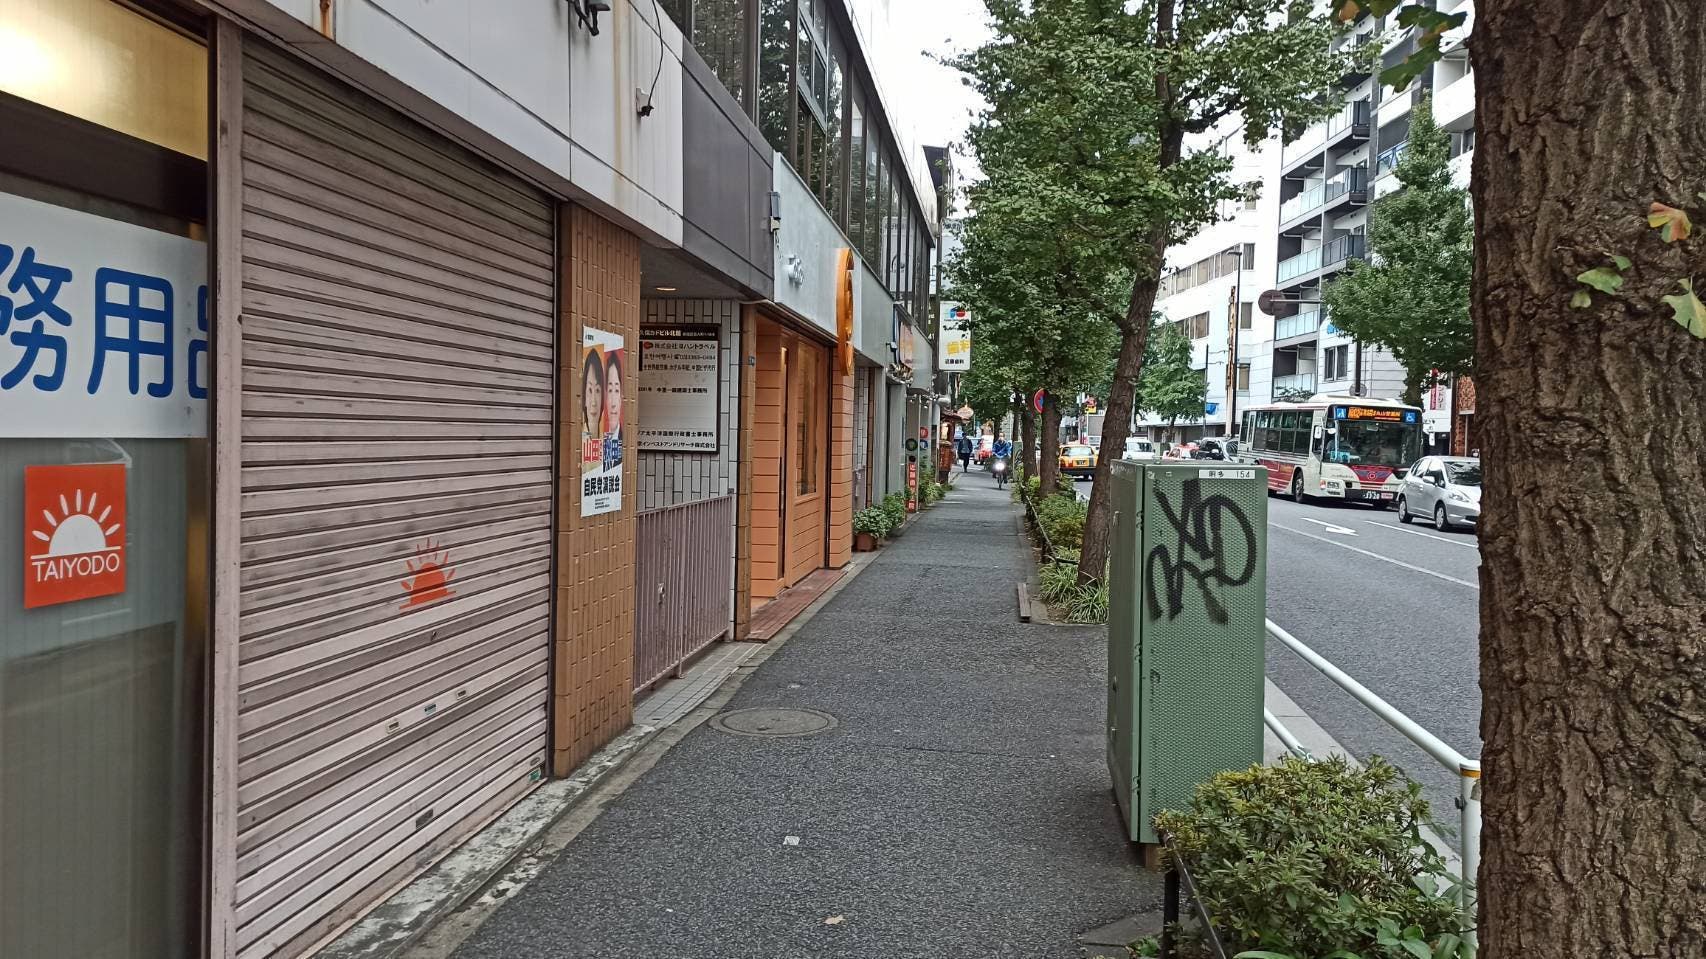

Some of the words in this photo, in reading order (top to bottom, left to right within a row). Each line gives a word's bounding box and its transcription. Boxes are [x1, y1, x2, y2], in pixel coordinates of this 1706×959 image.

[583, 474, 620, 497] 自民党演説会
[1235, 471, 1250, 479] 154
[31, 552, 121, 583] TAIYODO
